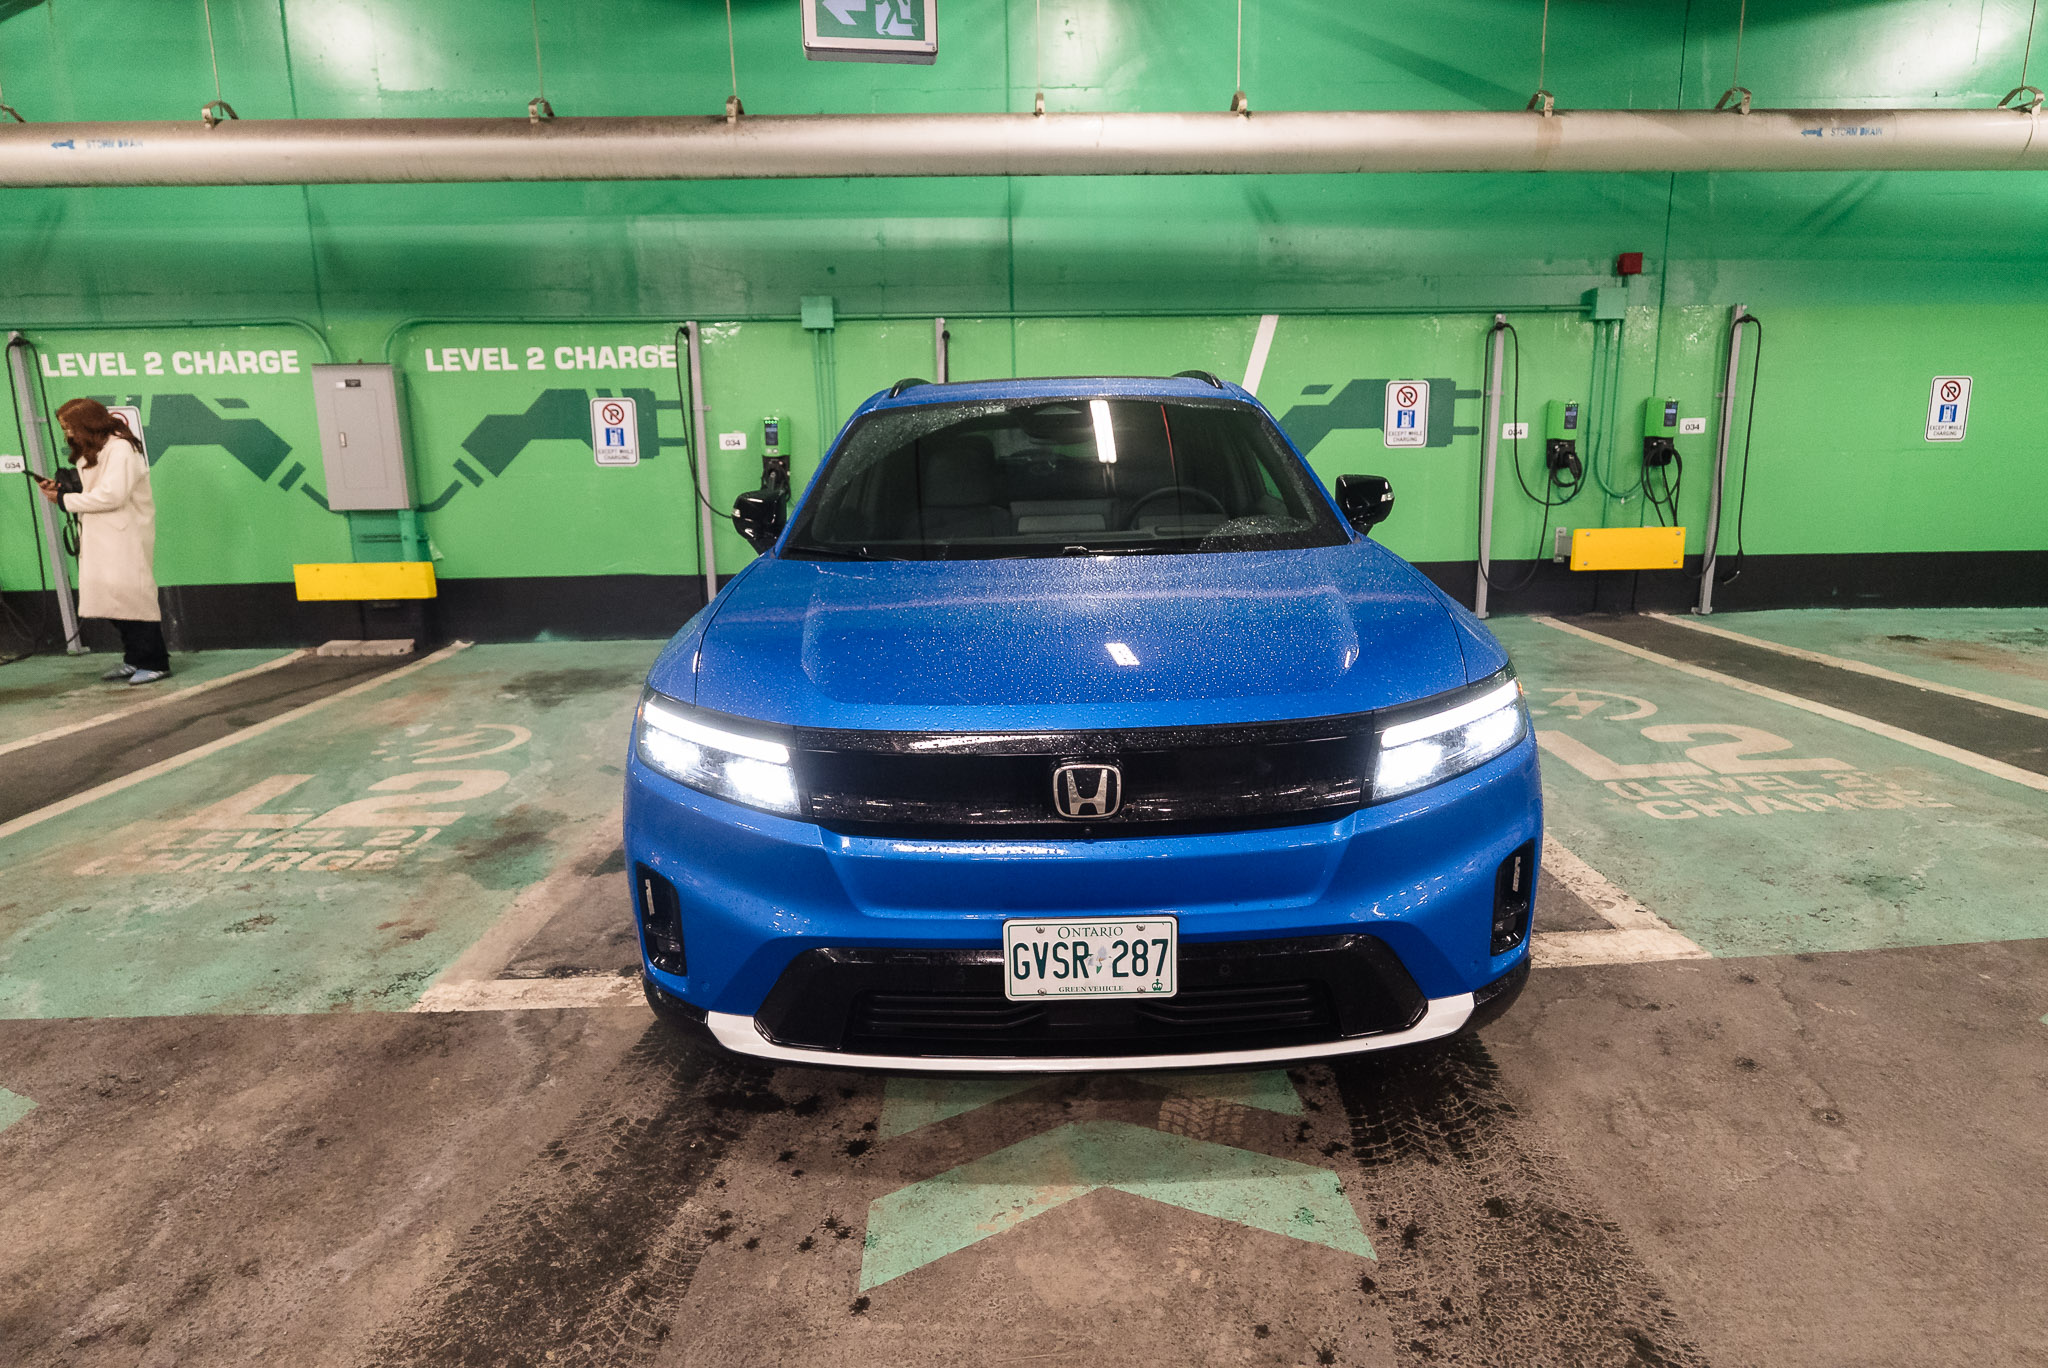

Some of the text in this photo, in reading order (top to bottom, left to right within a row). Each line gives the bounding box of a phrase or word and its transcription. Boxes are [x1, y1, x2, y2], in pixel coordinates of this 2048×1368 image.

[1831, 127, 1858, 137] STORM
[40, 350, 301, 377] LEVEL 2 CHARGE
[425, 345, 678, 372] LEVEL 2 CHARGE
[1507, 428, 1523, 436] 04
[1685, 423, 1700, 431] 034
[1636, 790, 1957, 819] CHARGE
[1013, 939, 1169, 980] GVSR 287
[1088, 985, 1124, 993] VEHICLE
